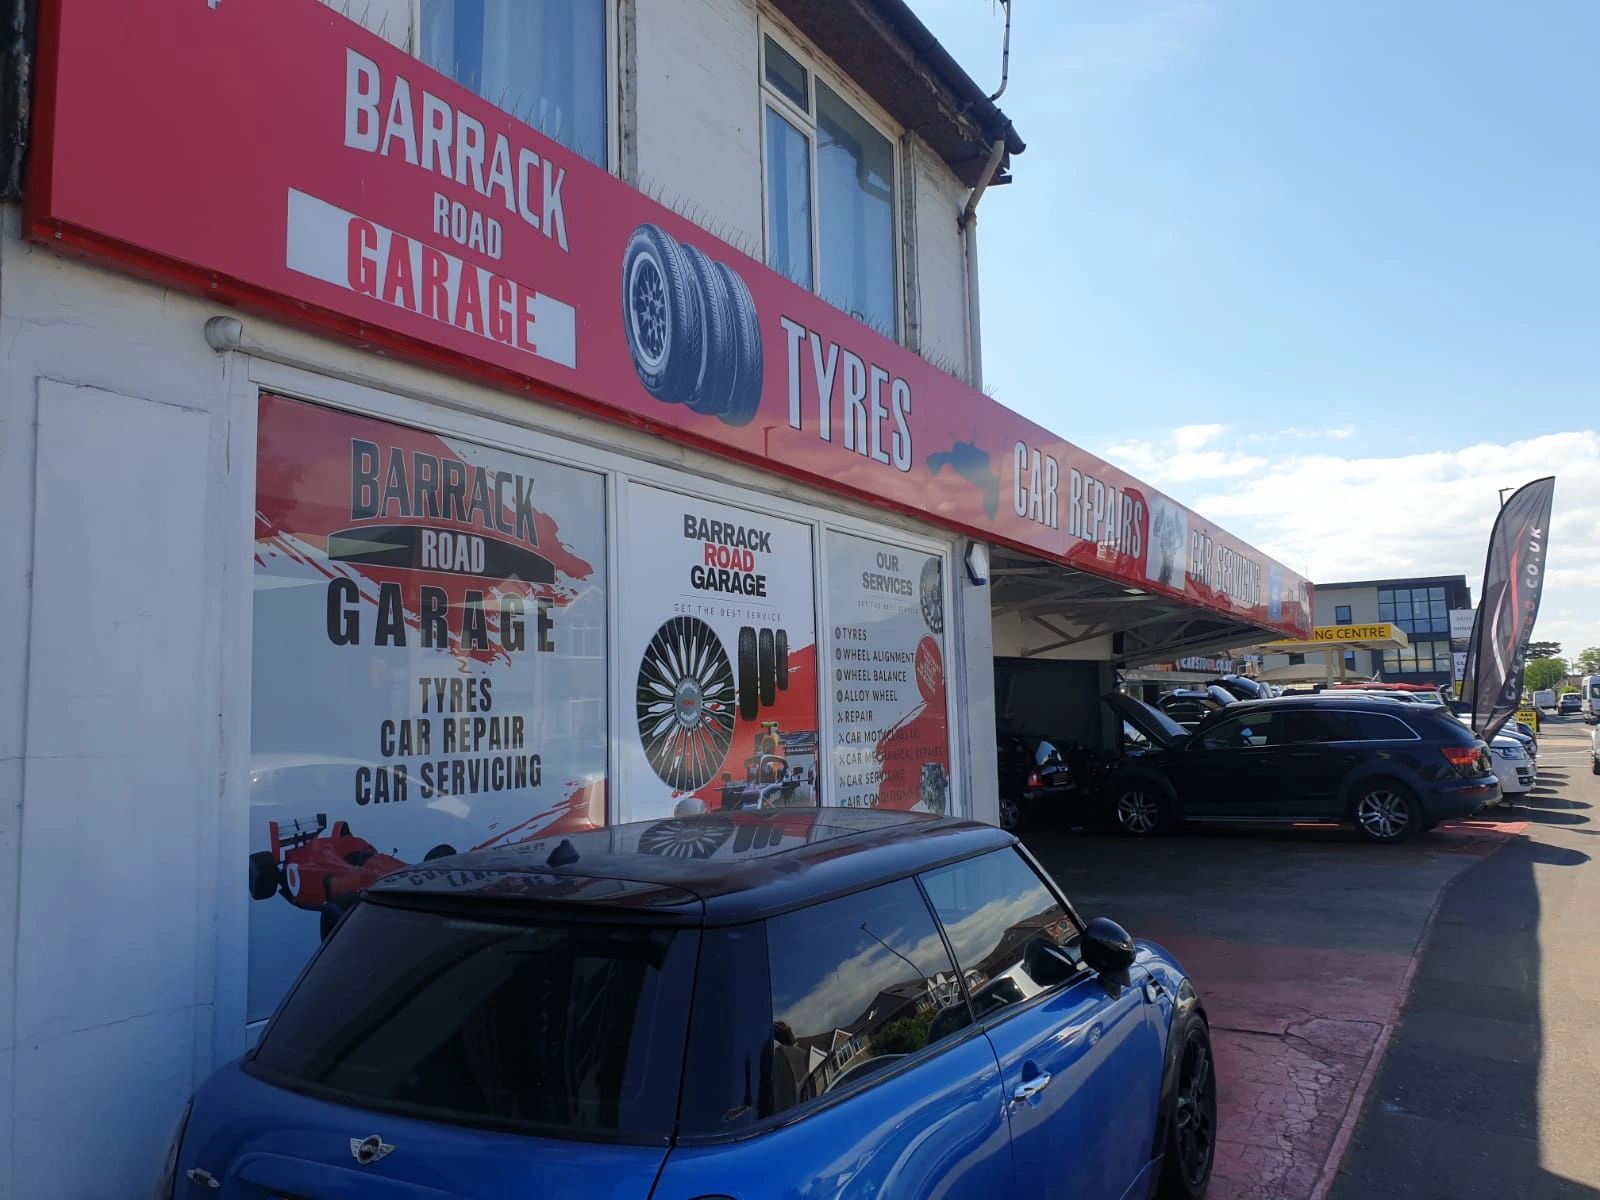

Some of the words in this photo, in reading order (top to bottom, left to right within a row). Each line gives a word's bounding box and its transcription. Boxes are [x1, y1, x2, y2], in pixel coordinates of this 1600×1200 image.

[344, 46, 570, 254] BARRACK
[433, 191, 502, 261] ROAD
[347, 216, 537, 354] GARAGE
[780, 314, 912, 473] TYRES
[350, 437, 541, 548] BARRACK
[1013, 440, 1059, 530] CAR
[1068, 466, 1143, 560] REPAIRS
[683, 513, 772, 554] BARRACK
[421, 528, 486, 574] ROAD
[704, 542, 755, 572] ROAD
[876, 552, 899, 572] OUR
[1191, 529, 1213, 587] CAR
[690, 565, 767, 598] GARAGE
[862, 571, 913, 597] SERVICES
[327, 576, 556, 653] GARAGE
[674, 603, 691, 613] GET
[698, 605, 714, 616] THE
[720, 607, 741, 618] BEST
[746, 610, 781, 622] SERVICE
[842, 627, 867, 641] TYRES
[1336, 626, 1385, 639] CENTRE
[843, 648, 871, 662] WHEEL
[872, 651, 915, 664] ALIGNMENT
[844, 669, 872, 682] WHEEL
[873, 670, 907, 683] BALANCE
[419, 677, 493, 714] TYRES
[844, 689, 870, 702] ALLOY
[872, 689, 898, 702] WHEEL
[844, 710, 873, 724] REPAIR
[380, 719, 430, 758] CAR
[443, 715, 525, 754] REPAIR
[845, 731, 864, 744] CAR
[846, 752, 862, 765] CAR
[355, 764, 408, 806] CAR
[420, 753, 542, 798] SERVICING
[847, 774, 863, 787] CAR
[847, 795, 861, 808] AIR
